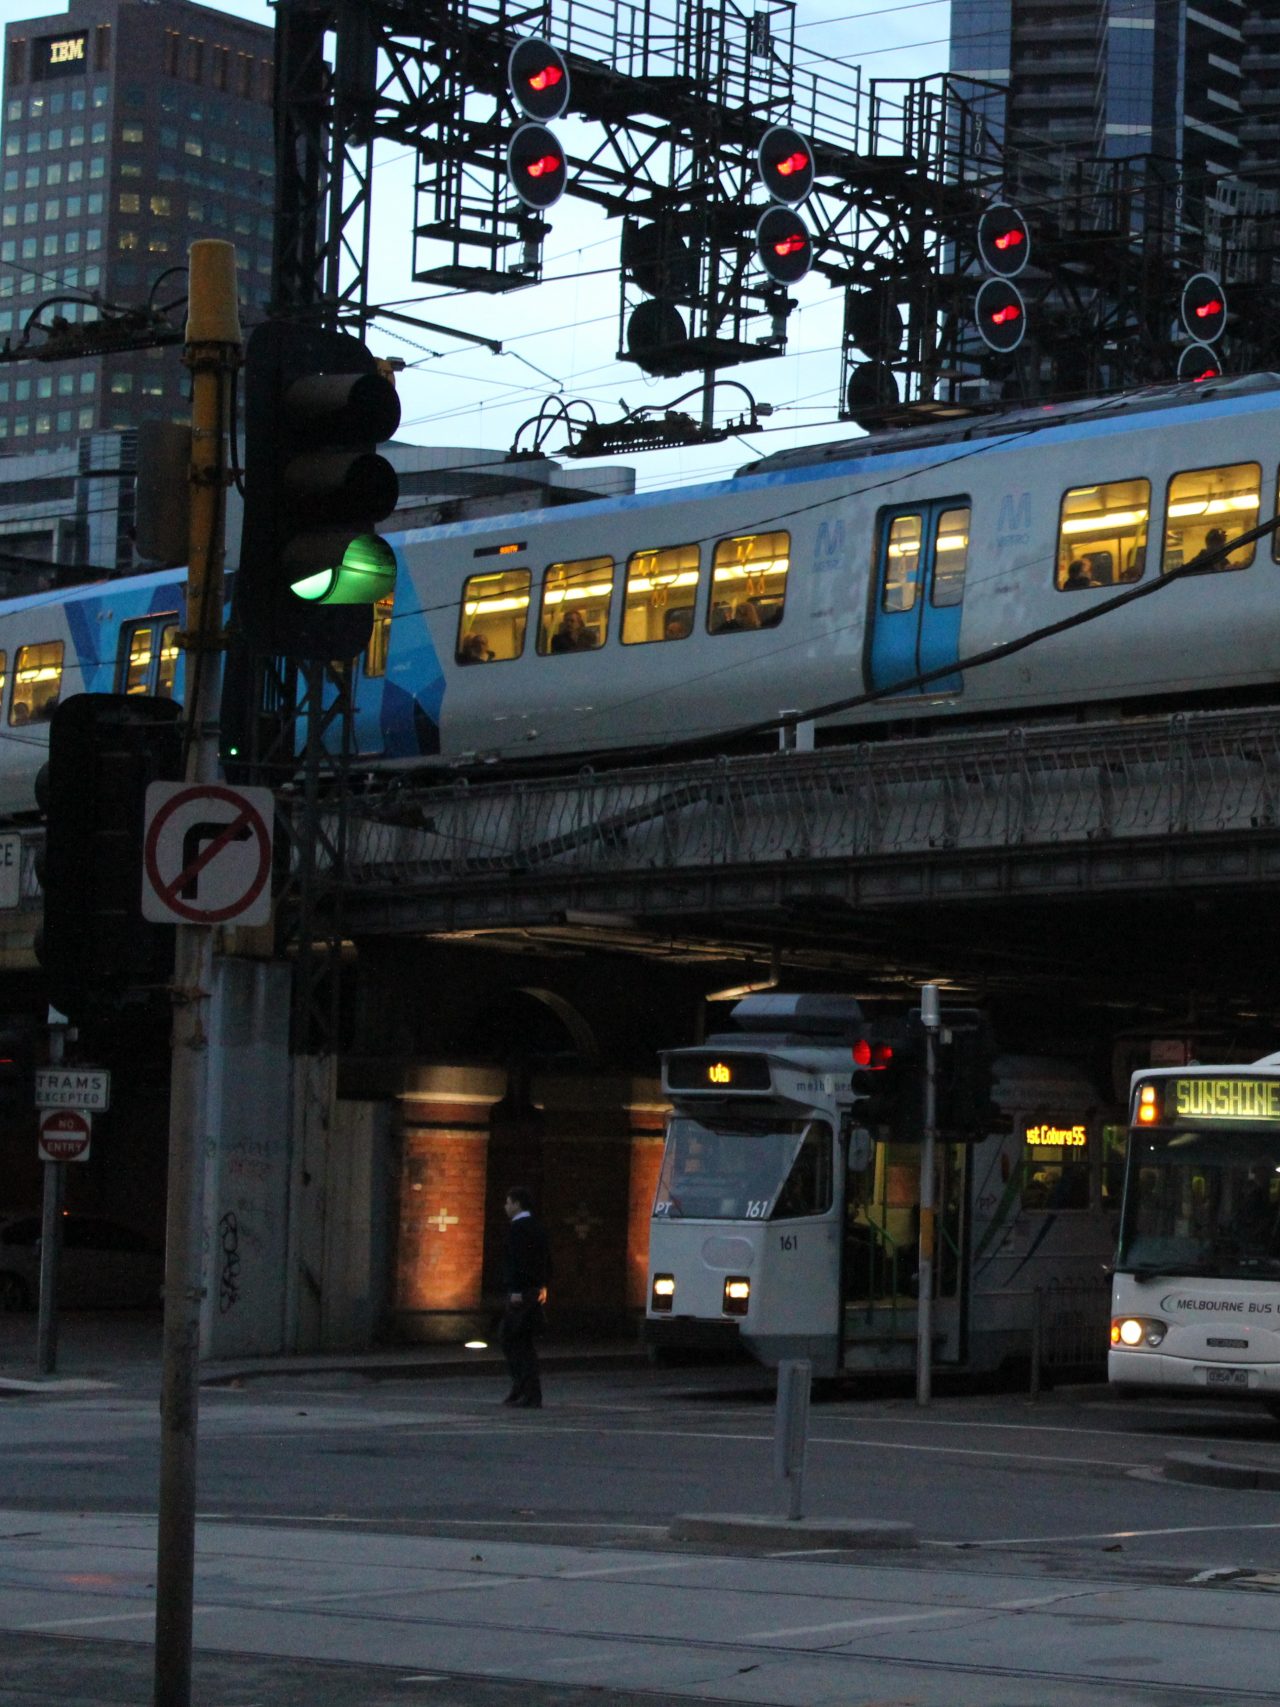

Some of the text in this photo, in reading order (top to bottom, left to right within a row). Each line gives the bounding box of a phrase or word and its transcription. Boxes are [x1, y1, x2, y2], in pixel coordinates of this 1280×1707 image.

[50, 37, 85, 64] IBM
[974, 114, 983, 155] 570
[708, 1062, 731, 1083] via
[37, 1075, 102, 1090] TRAMS
[36, 1091, 99, 1104] EXCEPTED
[1177, 1080, 1280, 1116] SUNSHINE
[58, 1119, 74, 1128] NO
[47, 1142, 82, 1152] ENTRY
[746, 1200, 768, 1218] 161
[780, 1236, 798, 1250] 161
[1177, 1299, 1244, 1313] MELBOURNE
[1248, 1301, 1272, 1313] BUS
